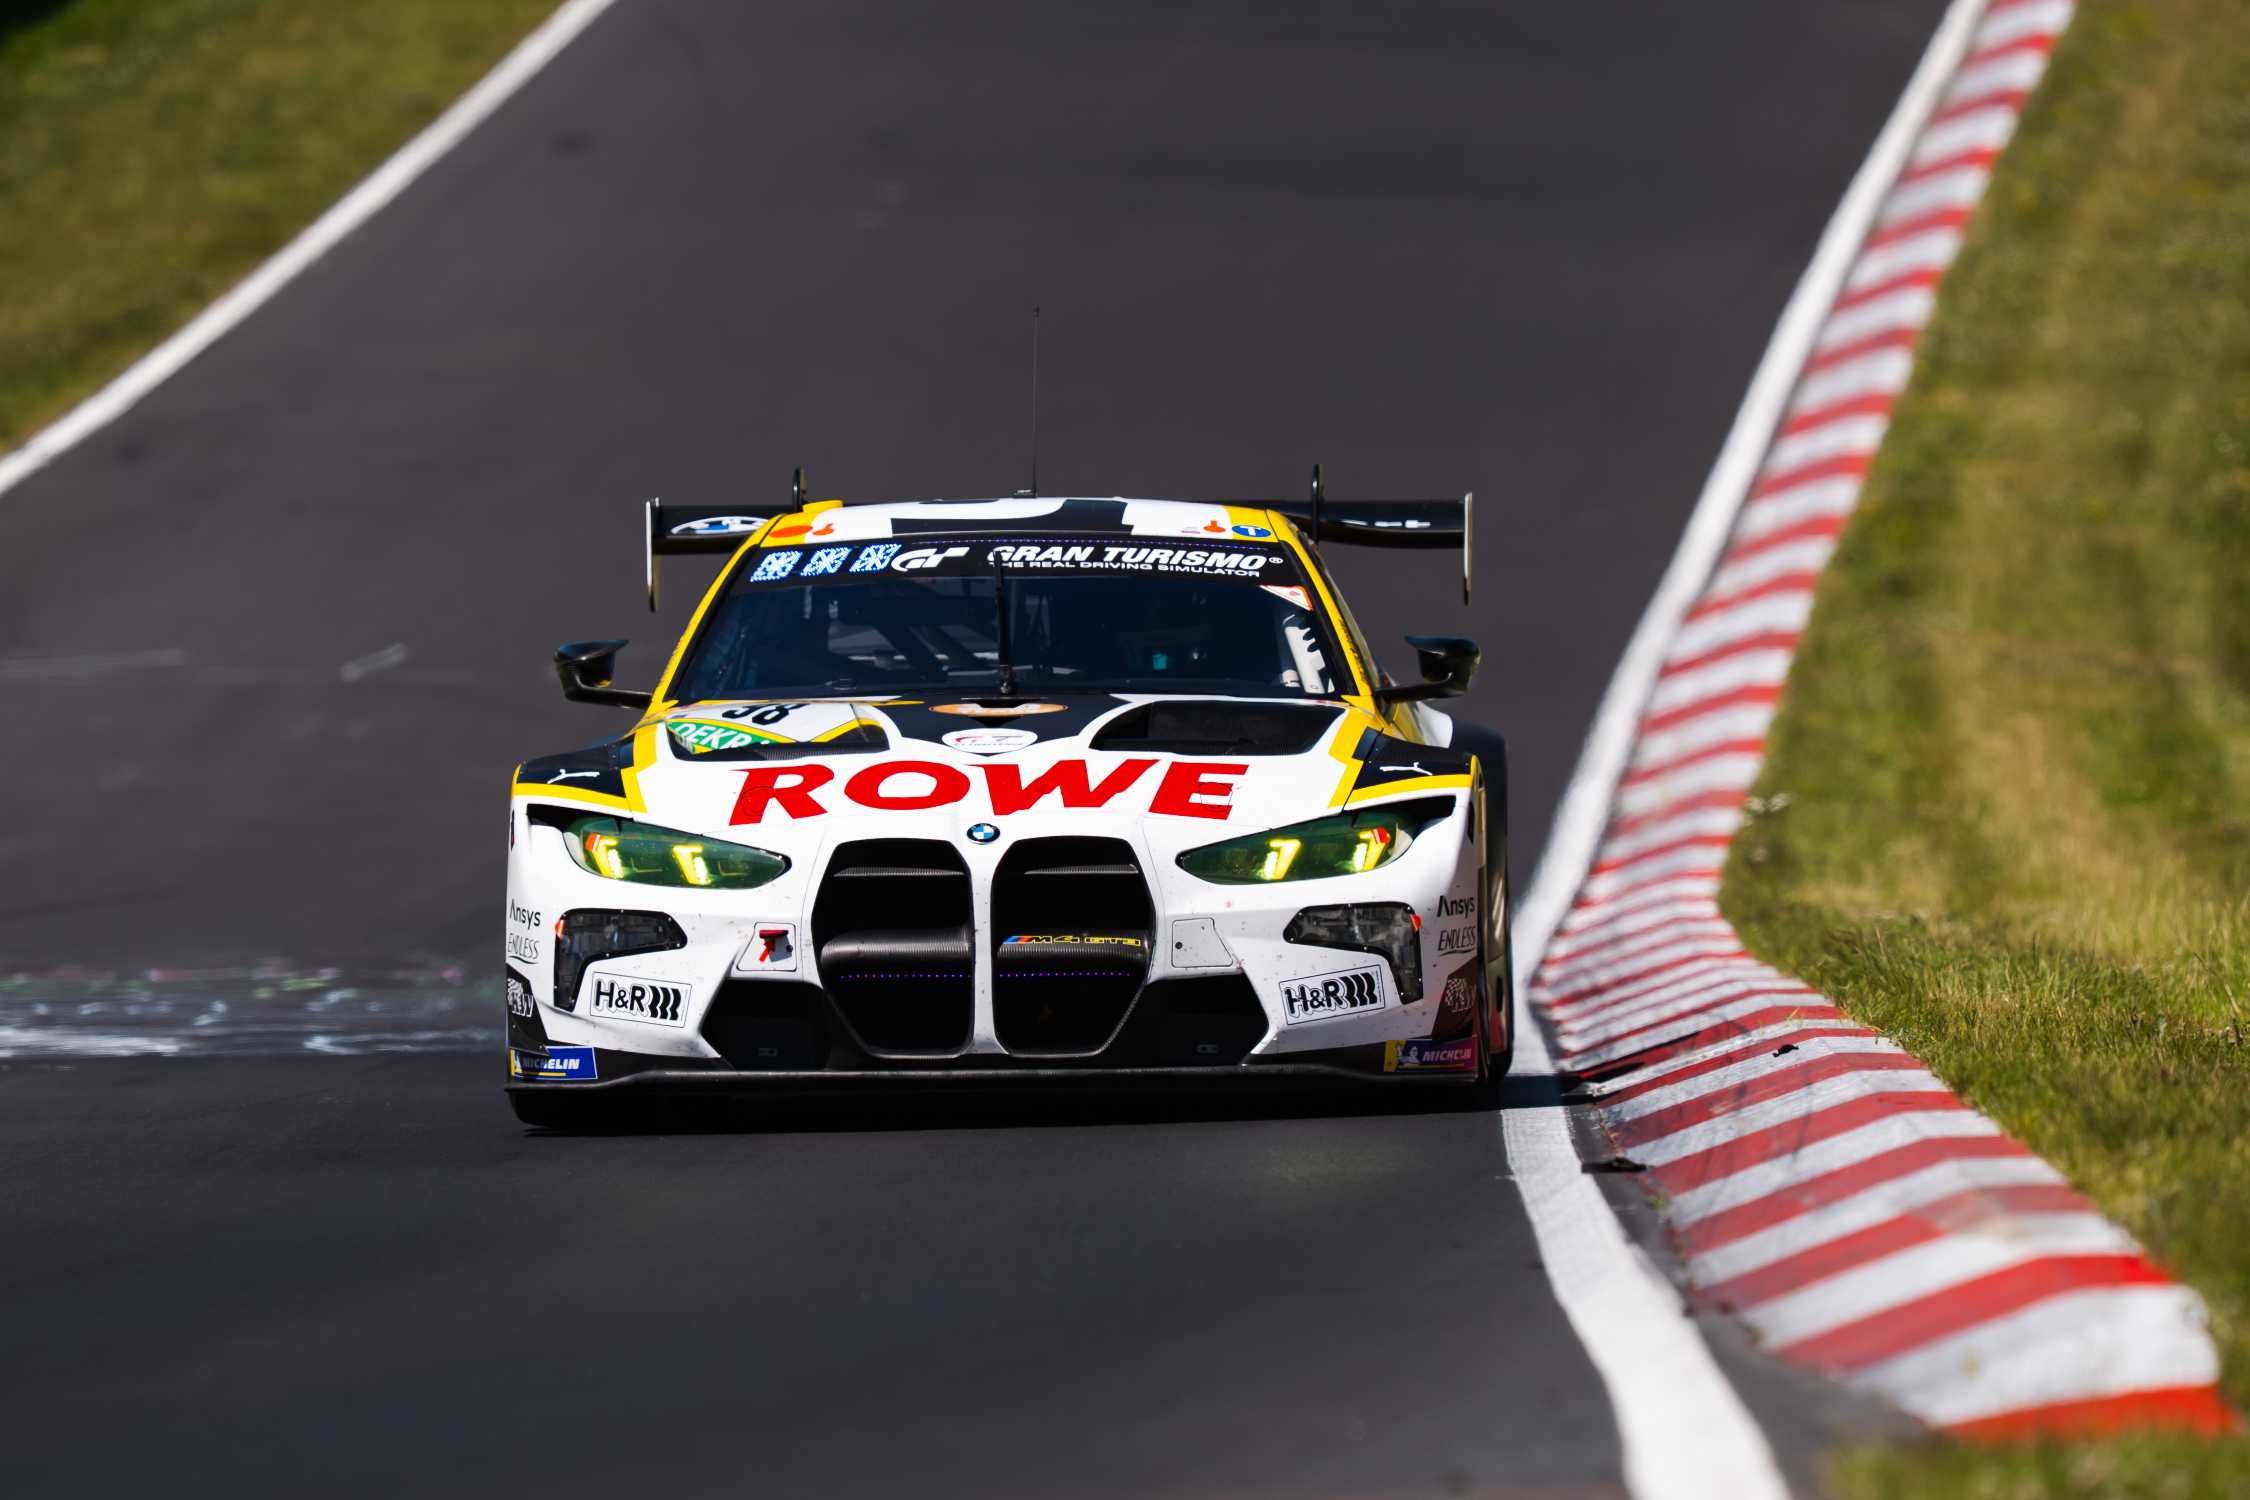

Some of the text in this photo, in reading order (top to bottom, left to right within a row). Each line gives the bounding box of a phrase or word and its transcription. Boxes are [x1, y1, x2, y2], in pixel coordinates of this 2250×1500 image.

[987, 545, 1095, 562] GRAN
[1078, 561, 1153, 570] DRIVING
[1158, 564, 1260, 578] SIMULATOR
[675, 722, 771, 750] DEKR
[728, 759, 1250, 826] ROWE
[509, 898, 541, 930] Ansys
[1436, 894, 1476, 919] Ansys
[594, 980, 647, 1013] H&R
[1284, 980, 1343, 1015] H&R
